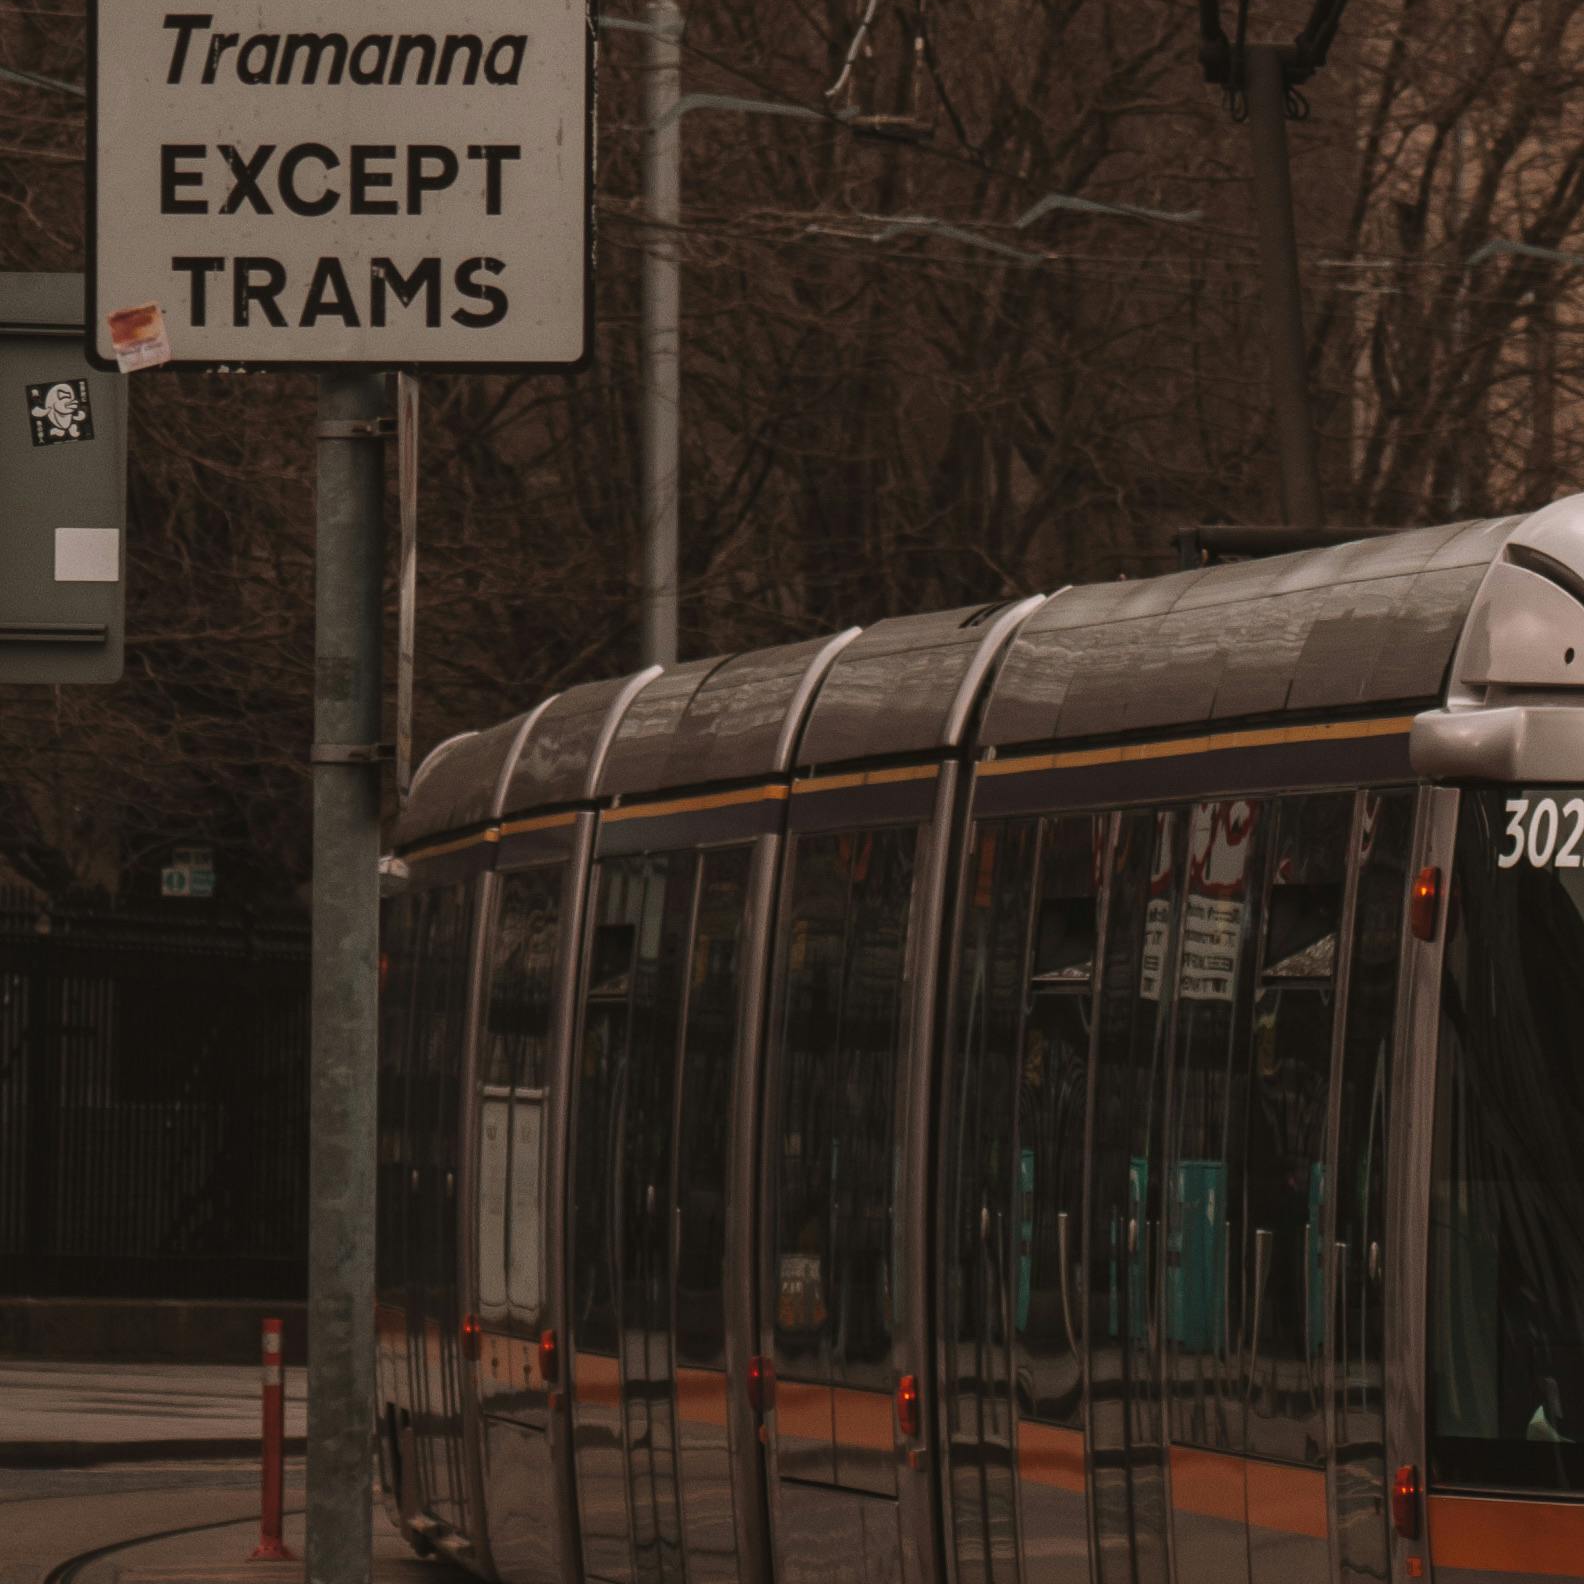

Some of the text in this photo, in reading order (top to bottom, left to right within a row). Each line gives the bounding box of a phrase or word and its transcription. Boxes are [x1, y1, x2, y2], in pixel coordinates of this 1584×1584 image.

[162, 13, 529, 86] Tramanna
[160, 143, 522, 216] EXCEPT
[171, 256, 510, 328] TRAMS
